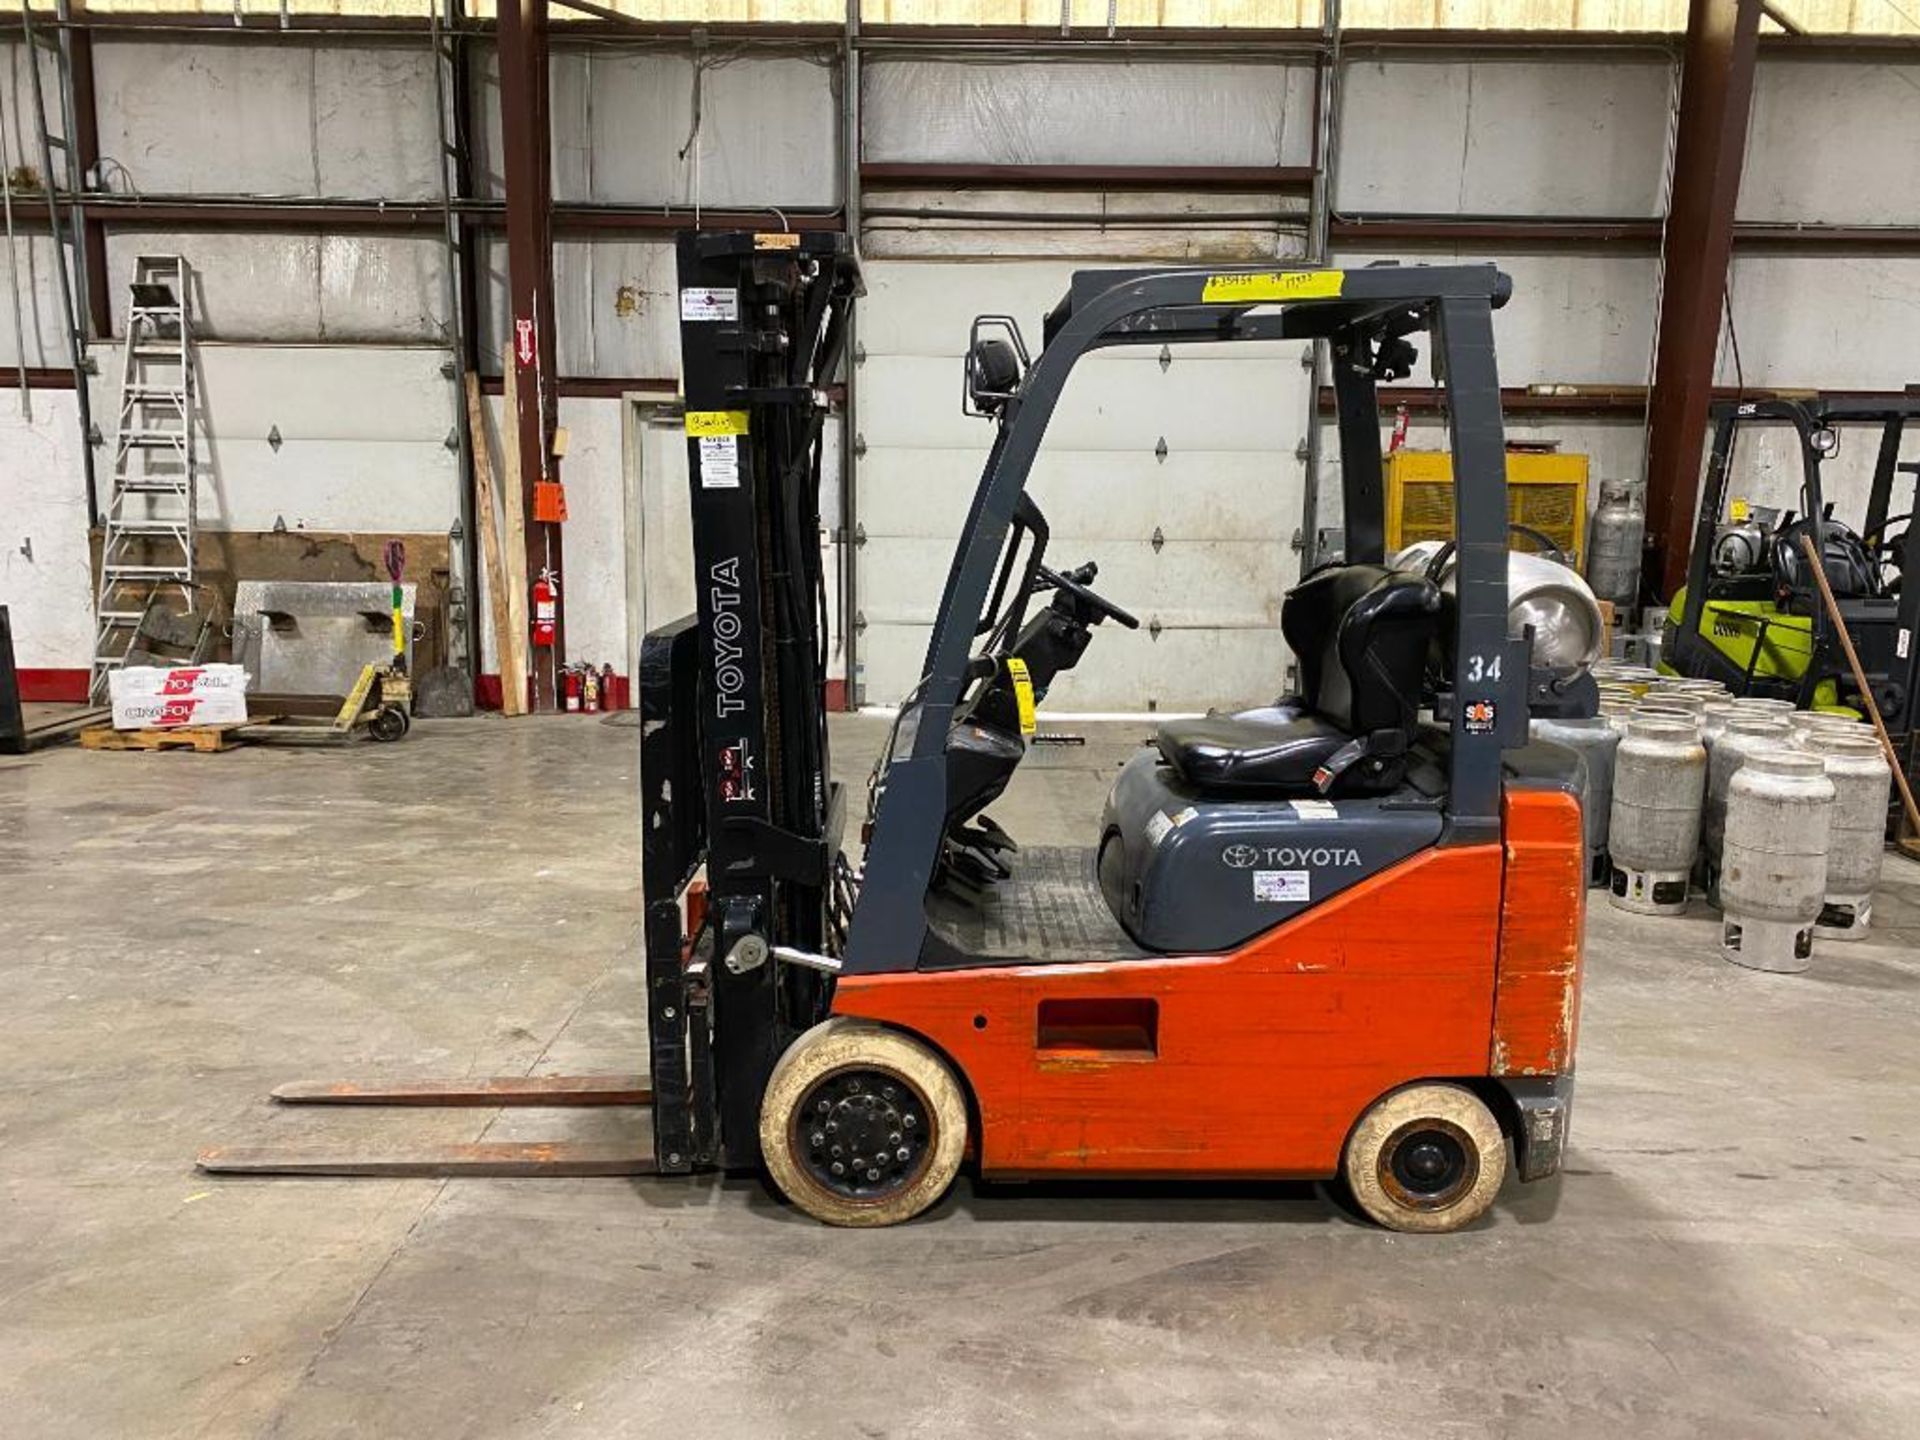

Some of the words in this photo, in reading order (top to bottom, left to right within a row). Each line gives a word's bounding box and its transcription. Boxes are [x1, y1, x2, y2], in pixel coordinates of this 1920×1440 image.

[711, 556, 745, 718] TOYOTA
[1467, 654, 1502, 682] 34
[1262, 847, 1362, 867] TOYOTA
